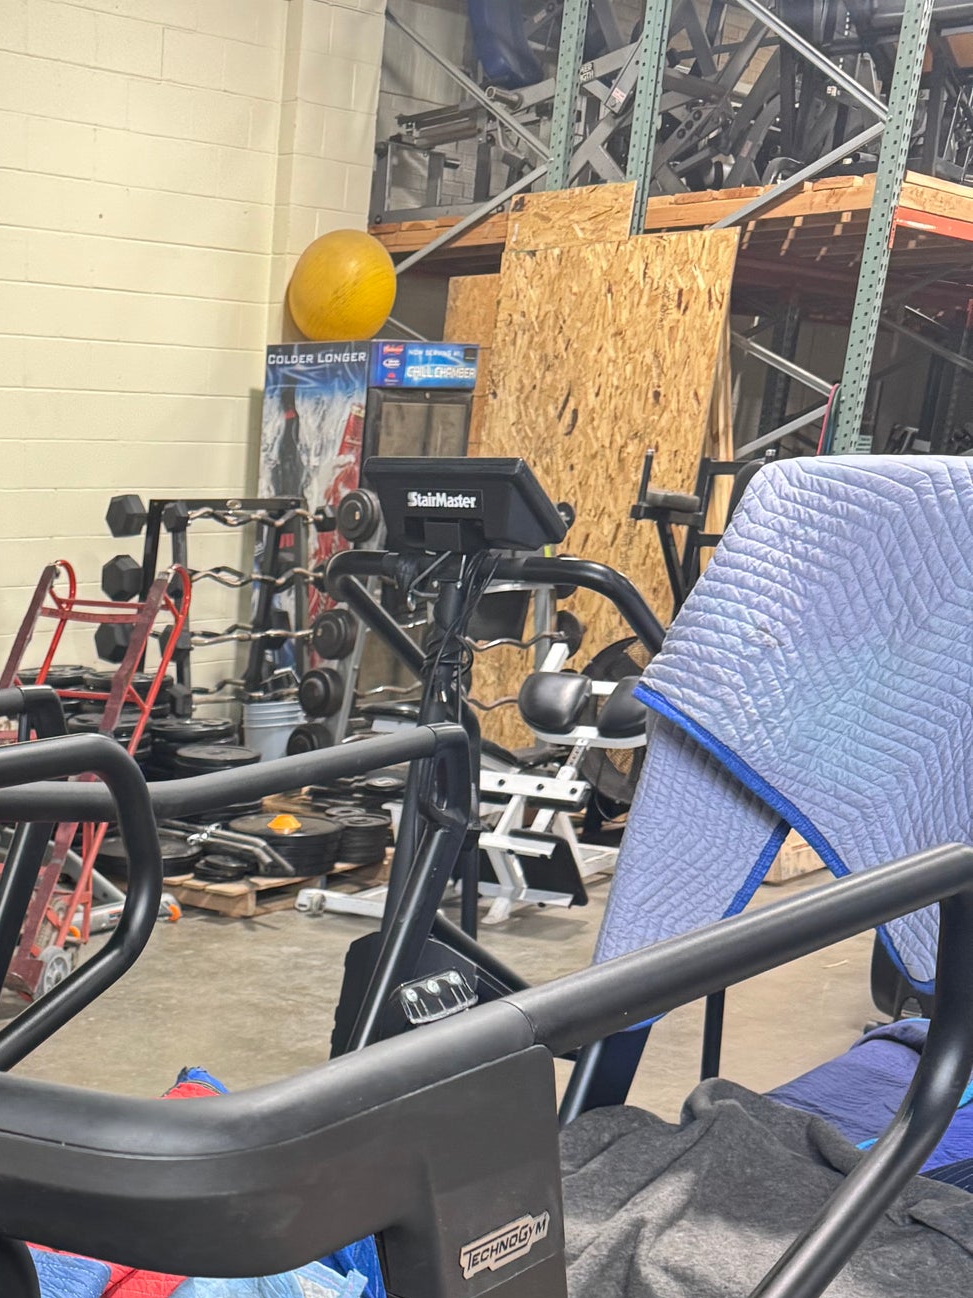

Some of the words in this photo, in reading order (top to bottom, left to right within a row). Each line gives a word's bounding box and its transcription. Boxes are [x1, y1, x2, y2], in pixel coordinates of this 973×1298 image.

[267, 353, 314, 365] COLDER
[317, 351, 367, 364] LONGER
[407, 491, 476, 508] StairMaster
[463, 1218, 547, 1271] TECHNOGYM
